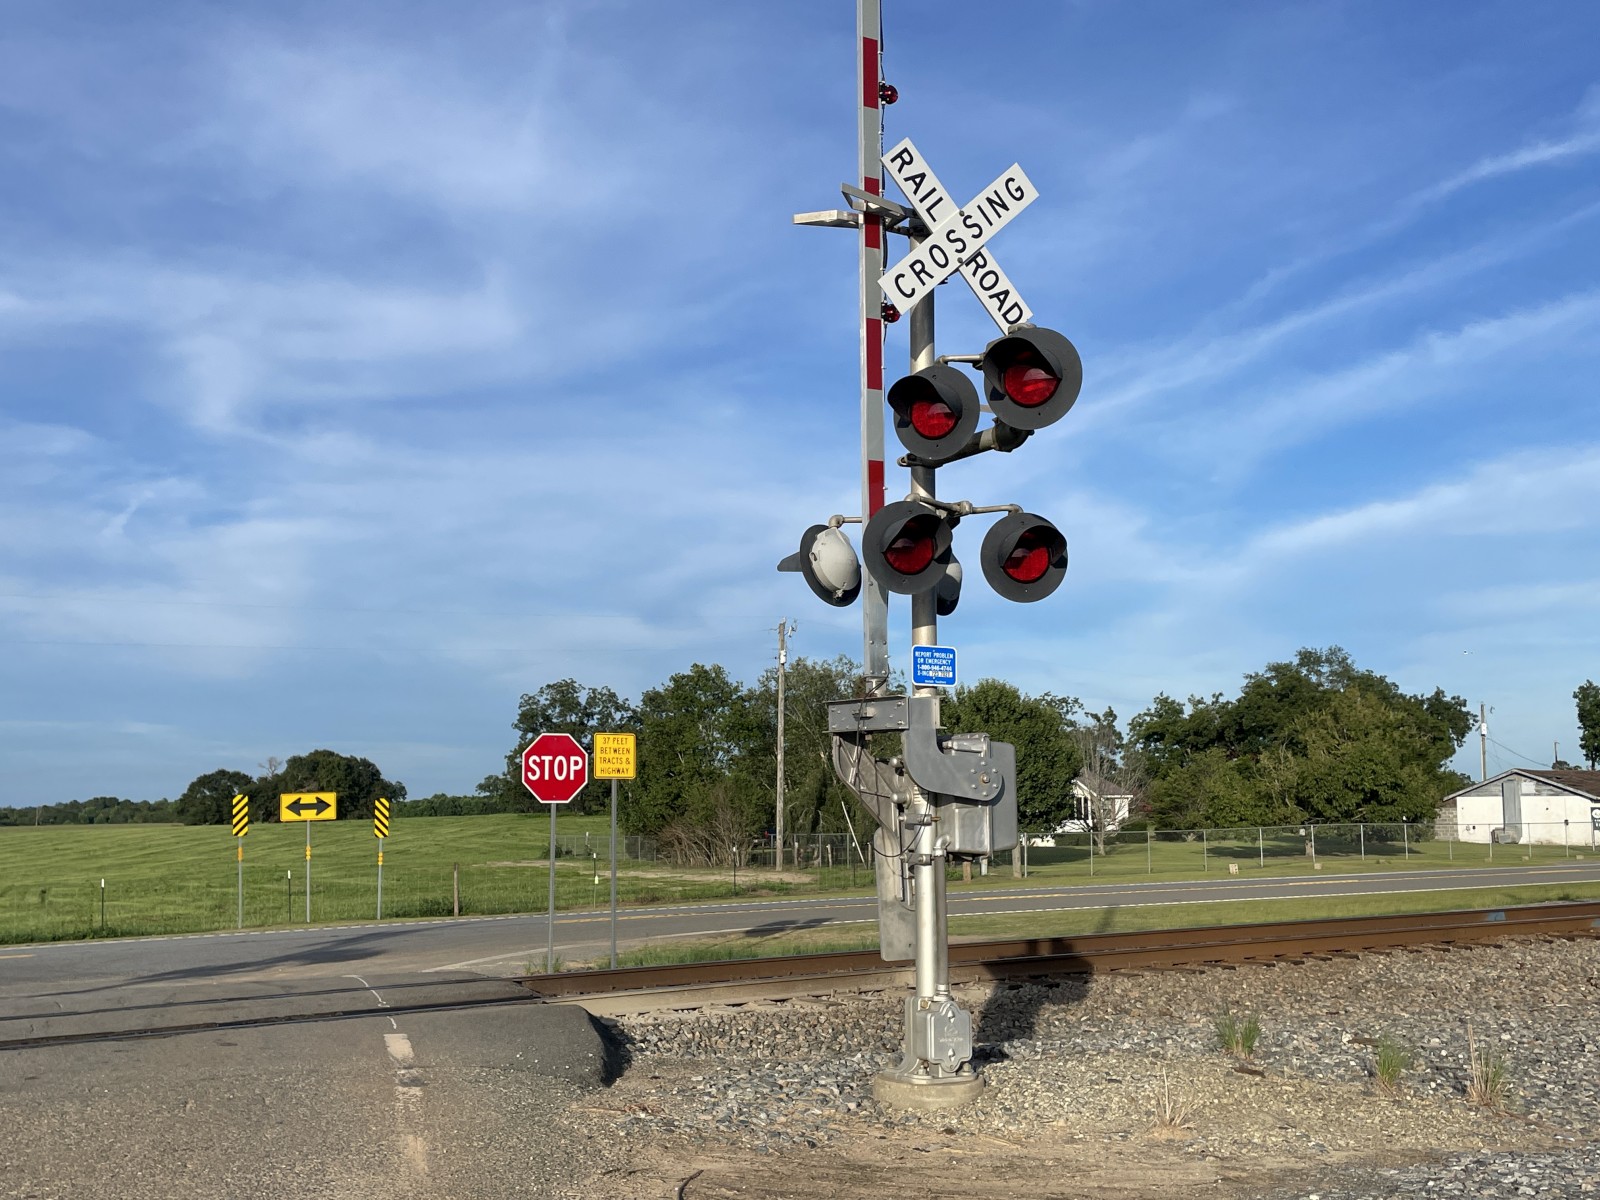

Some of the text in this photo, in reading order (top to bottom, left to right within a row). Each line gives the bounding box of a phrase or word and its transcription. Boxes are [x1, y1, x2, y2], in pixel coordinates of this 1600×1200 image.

[890, 146, 1024, 325] RAIL ROAD
[894, 177, 1025, 299] CROSSING
[602, 736, 628, 745] 37 FEET
[600, 746, 630, 755] BETWEEN
[599, 756, 631, 765] TRACTS &
[527, 755, 583, 781] STOP
[600, 767, 630, 775] HIGHWAY
